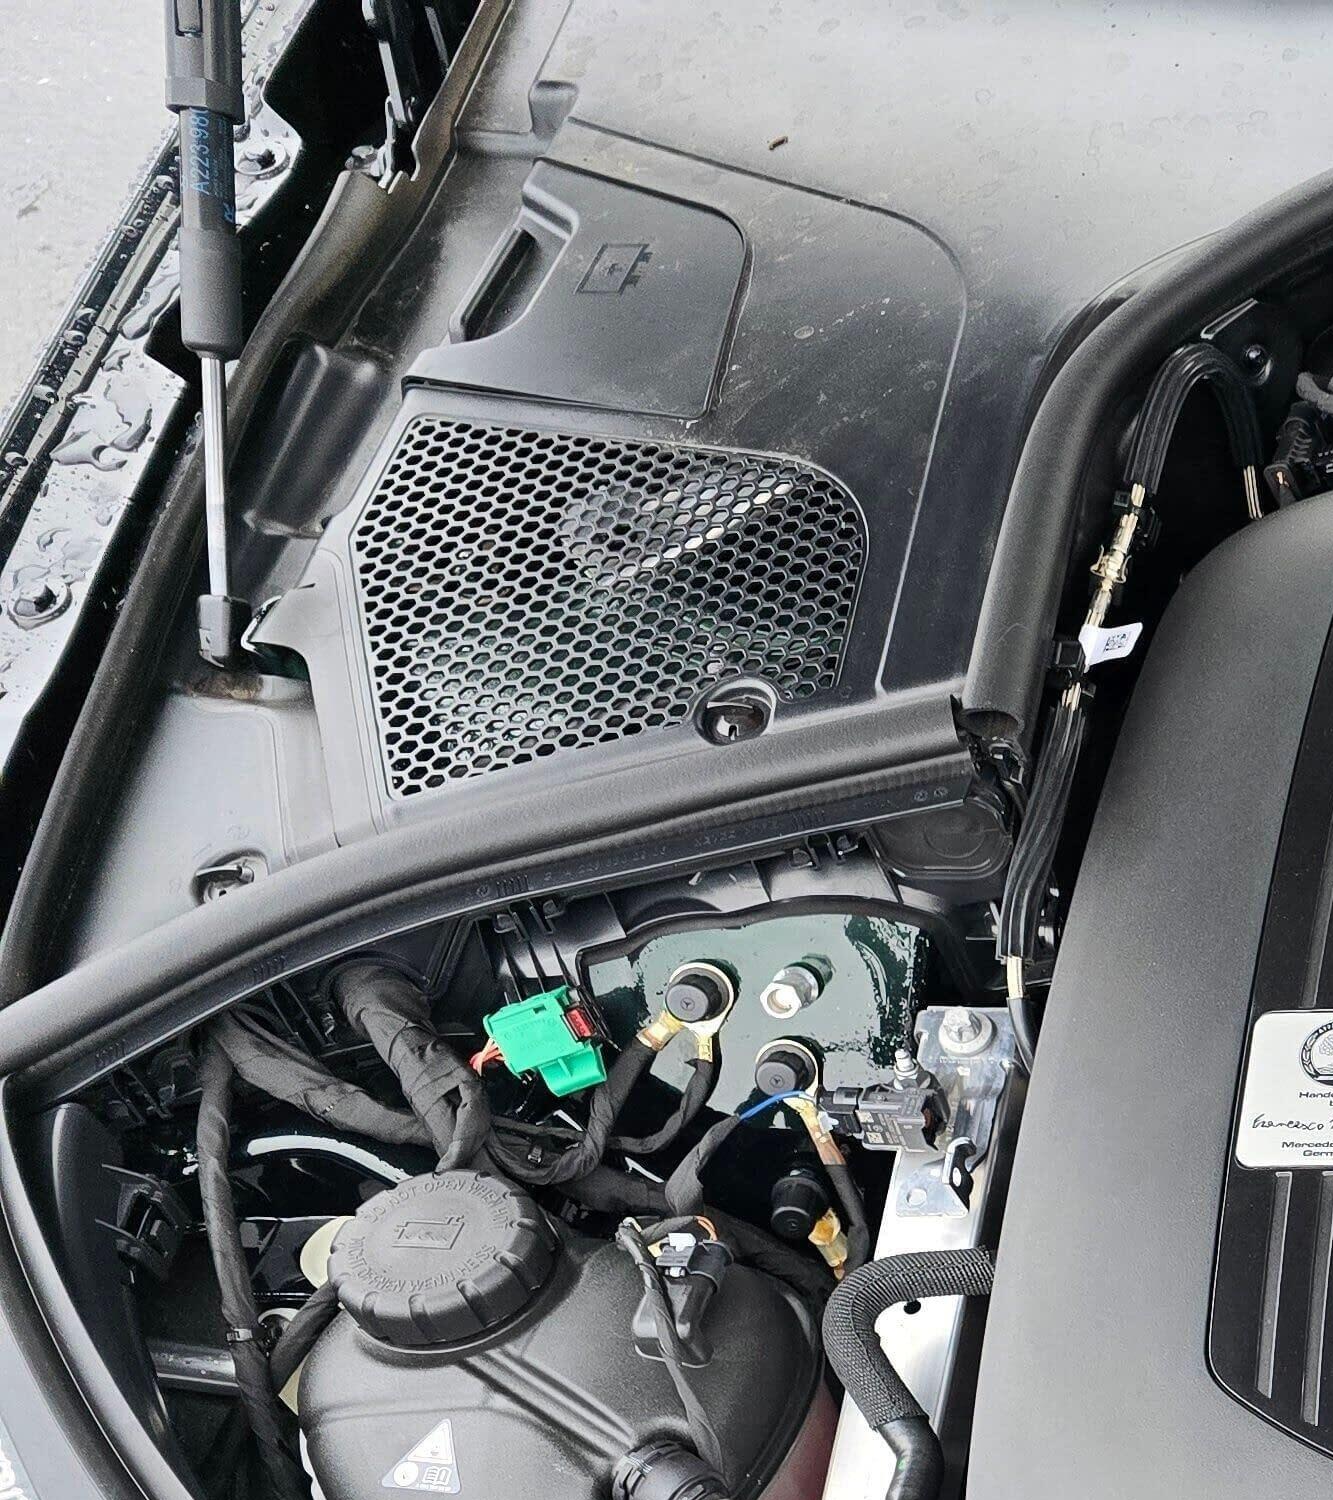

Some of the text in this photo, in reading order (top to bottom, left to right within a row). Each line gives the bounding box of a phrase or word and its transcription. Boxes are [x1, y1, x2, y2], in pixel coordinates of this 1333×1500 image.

[189, 143, 211, 196] A223
[424, 1178, 466, 1192] OPEN
[469, 1181, 502, 1208] WHEN
[410, 1271, 455, 1292] WENN
